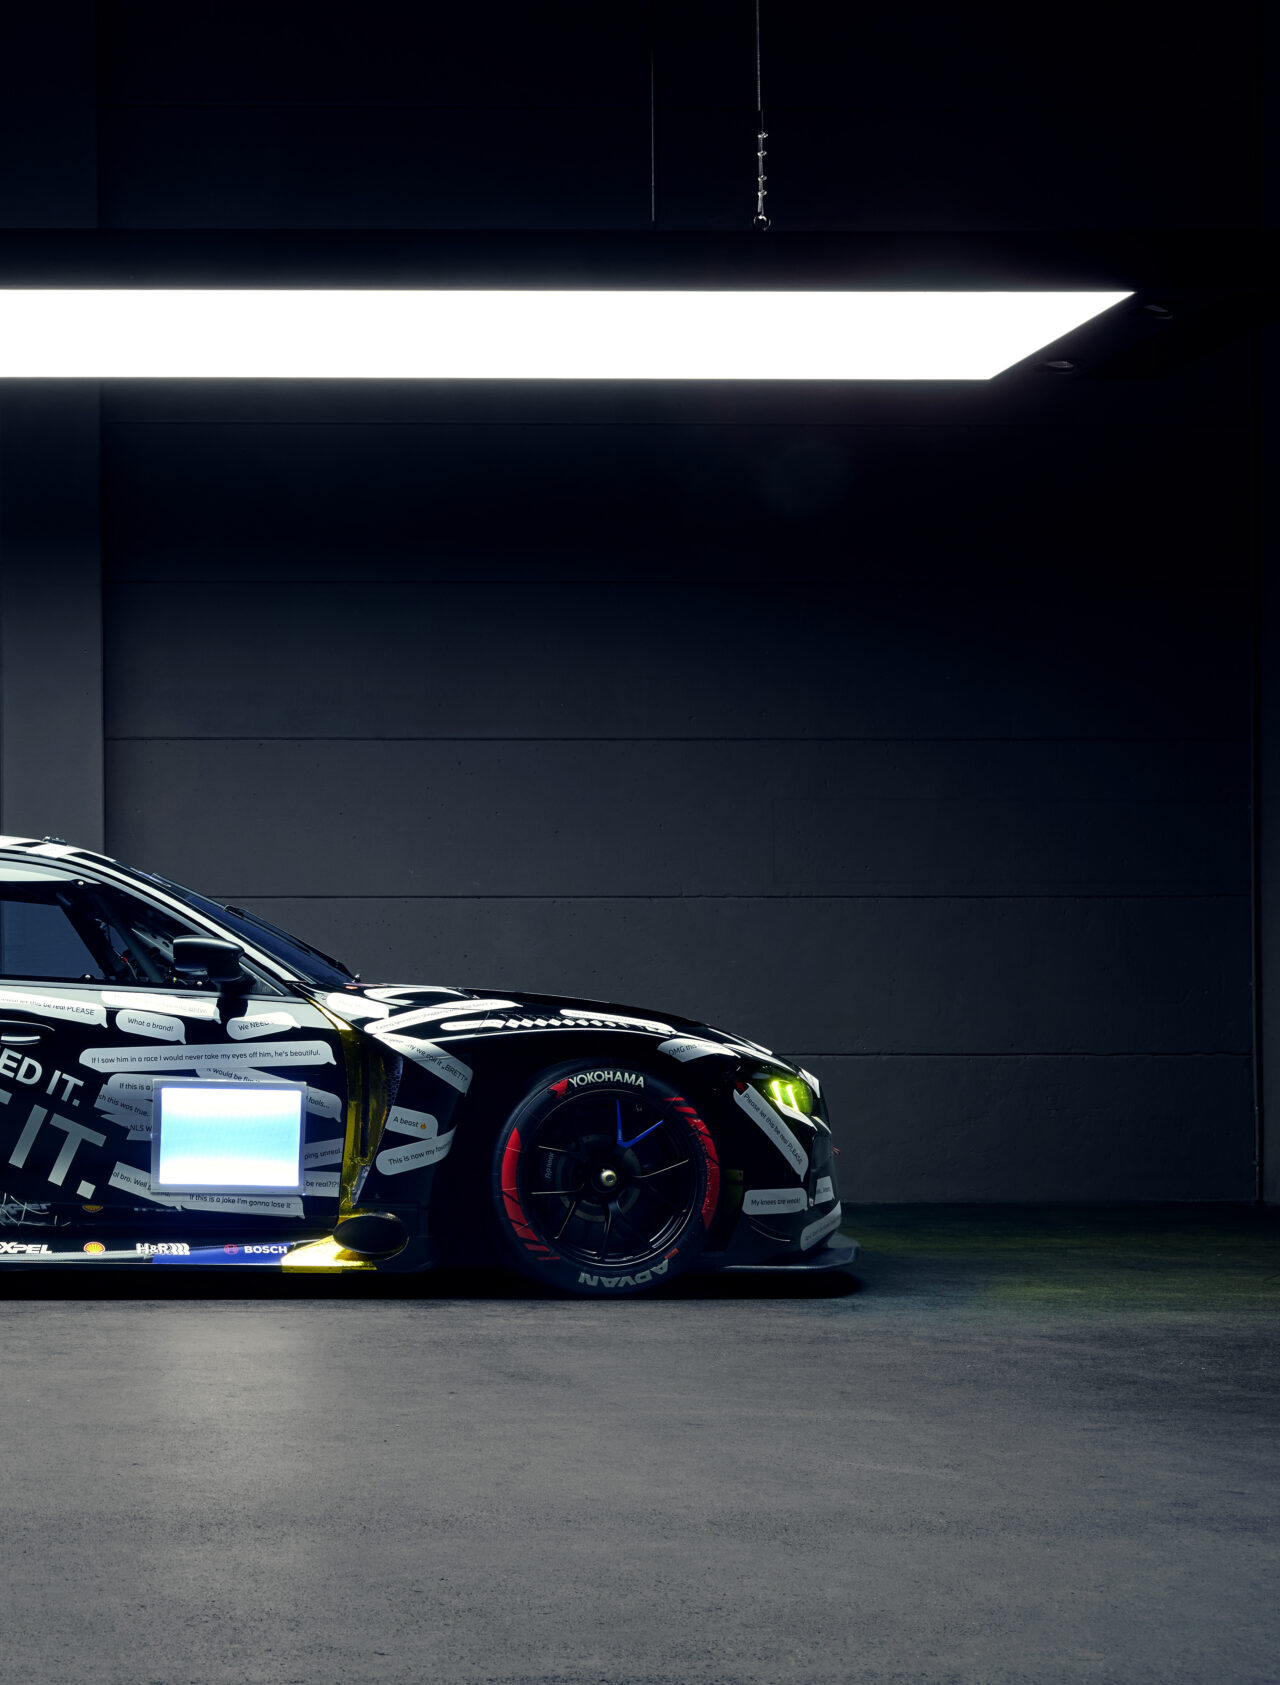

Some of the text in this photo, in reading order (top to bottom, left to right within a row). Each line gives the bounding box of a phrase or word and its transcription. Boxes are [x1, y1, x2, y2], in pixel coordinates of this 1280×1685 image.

[67, 1005, 95, 1016] PLEASE
[127, 1017, 145, 1028] What
[152, 1022, 174, 1033] brand!
[238, 1023, 250, 1031] We
[220, 1053, 231, 1061] my
[231, 1053, 248, 1061] eyes
[259, 1051, 274, 1059] him,
[289, 1049, 321, 1057] beautiful.
[416, 1048, 426, 1056] we
[669, 1045, 686, 1056] OMG
[685, 1043, 697, 1051] this
[213, 1068, 233, 1078] would
[233, 1073, 243, 1081] be
[568, 1071, 644, 1088] YOKOHAMA
[46, 1070, 84, 1107] IT.
[107, 1096, 119, 1106] this
[120, 1103, 133, 1111] was
[400, 1117, 419, 1128] beast
[744, 1094, 761, 1113] Please
[766, 1117, 775, 1129] this
[787, 1142, 803, 1165] PLEASE
[8, 1104, 107, 1199] IT.
[388, 1158, 402, 1166] This
[410, 1152, 425, 1160] now
[120, 1174, 133, 1183] bro.
[133, 1178, 148, 1188] Well
[195, 1194, 208, 1202] this
[751, 1199, 759, 1207] My
[244, 1245, 288, 1254] BOSCH
[578, 1259, 669, 1288] ADVAN
